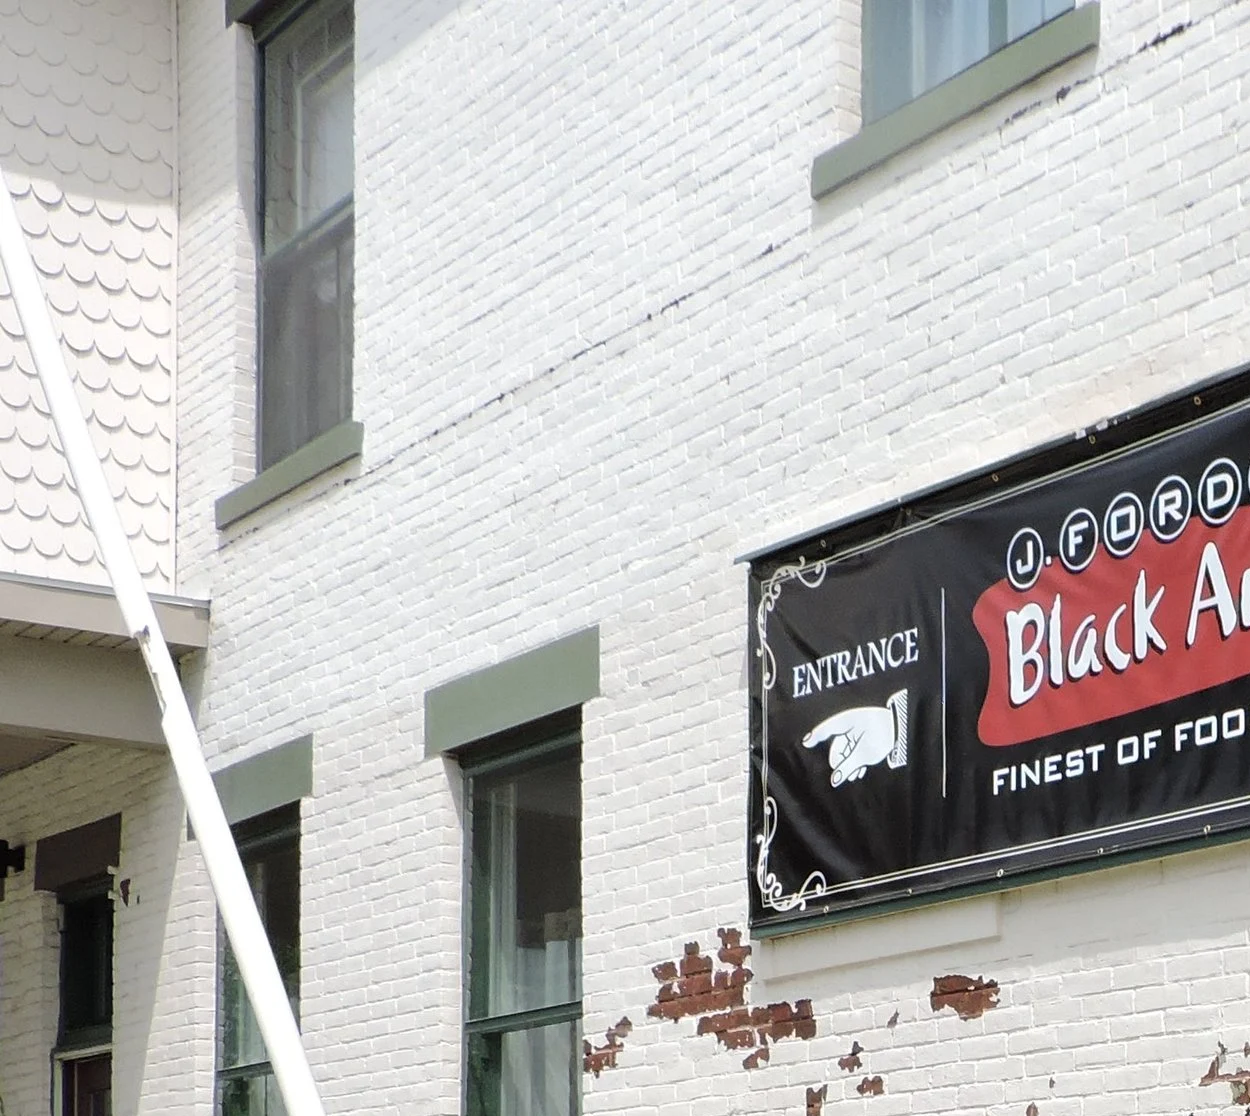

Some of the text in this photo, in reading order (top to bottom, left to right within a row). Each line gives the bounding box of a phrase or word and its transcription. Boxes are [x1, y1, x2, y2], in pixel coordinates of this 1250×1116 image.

[792, 626, 919, 699] ENTRANCE
[1005, 569, 1167, 705] Black
[992, 743, 1106, 796] FINEST
[1117, 729, 1162, 766] OF
